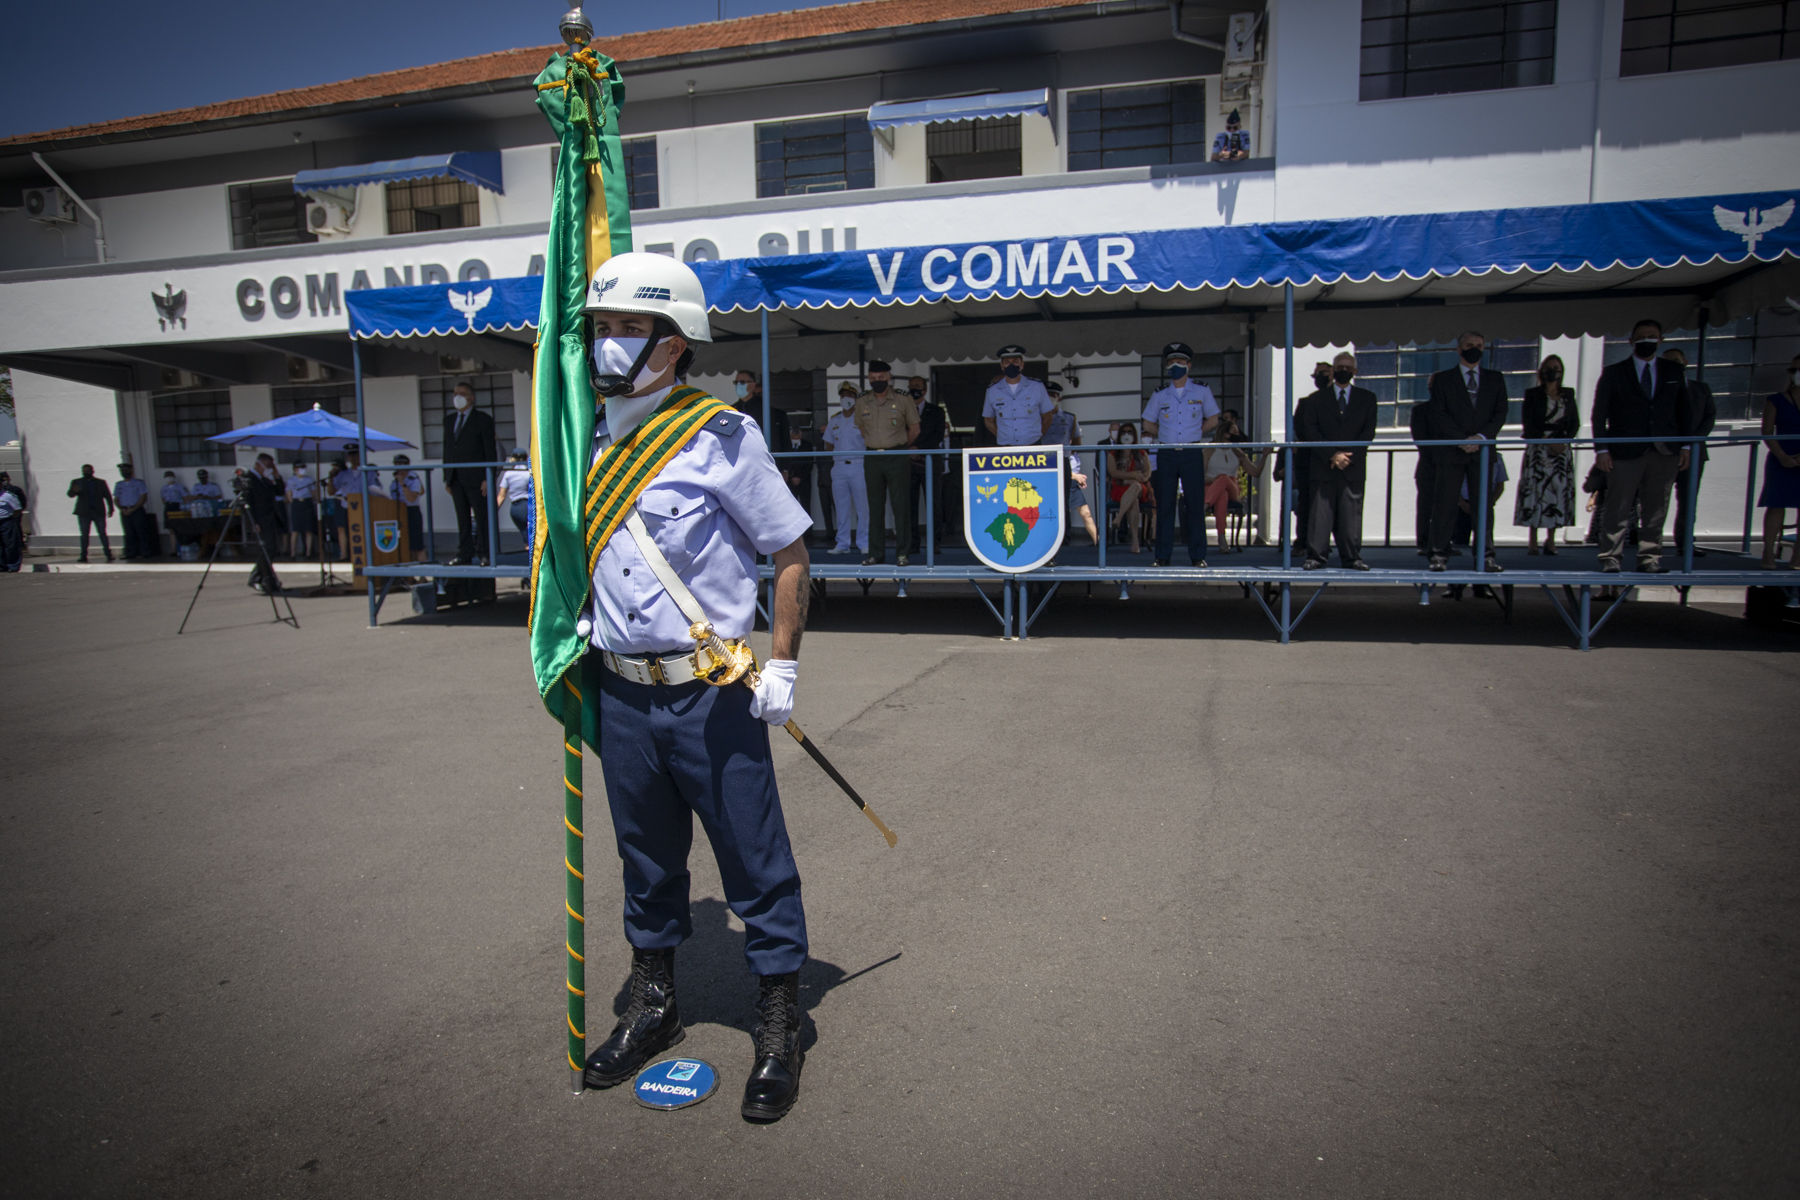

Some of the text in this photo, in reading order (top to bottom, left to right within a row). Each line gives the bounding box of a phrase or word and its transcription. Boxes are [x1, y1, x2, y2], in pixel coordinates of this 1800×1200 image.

[867, 237, 1138, 296] V COMAR
[975, 454, 1047, 469] V COMAR
[350, 501, 359, 511] V
[640, 1081, 697, 1097] BANDEIRA
